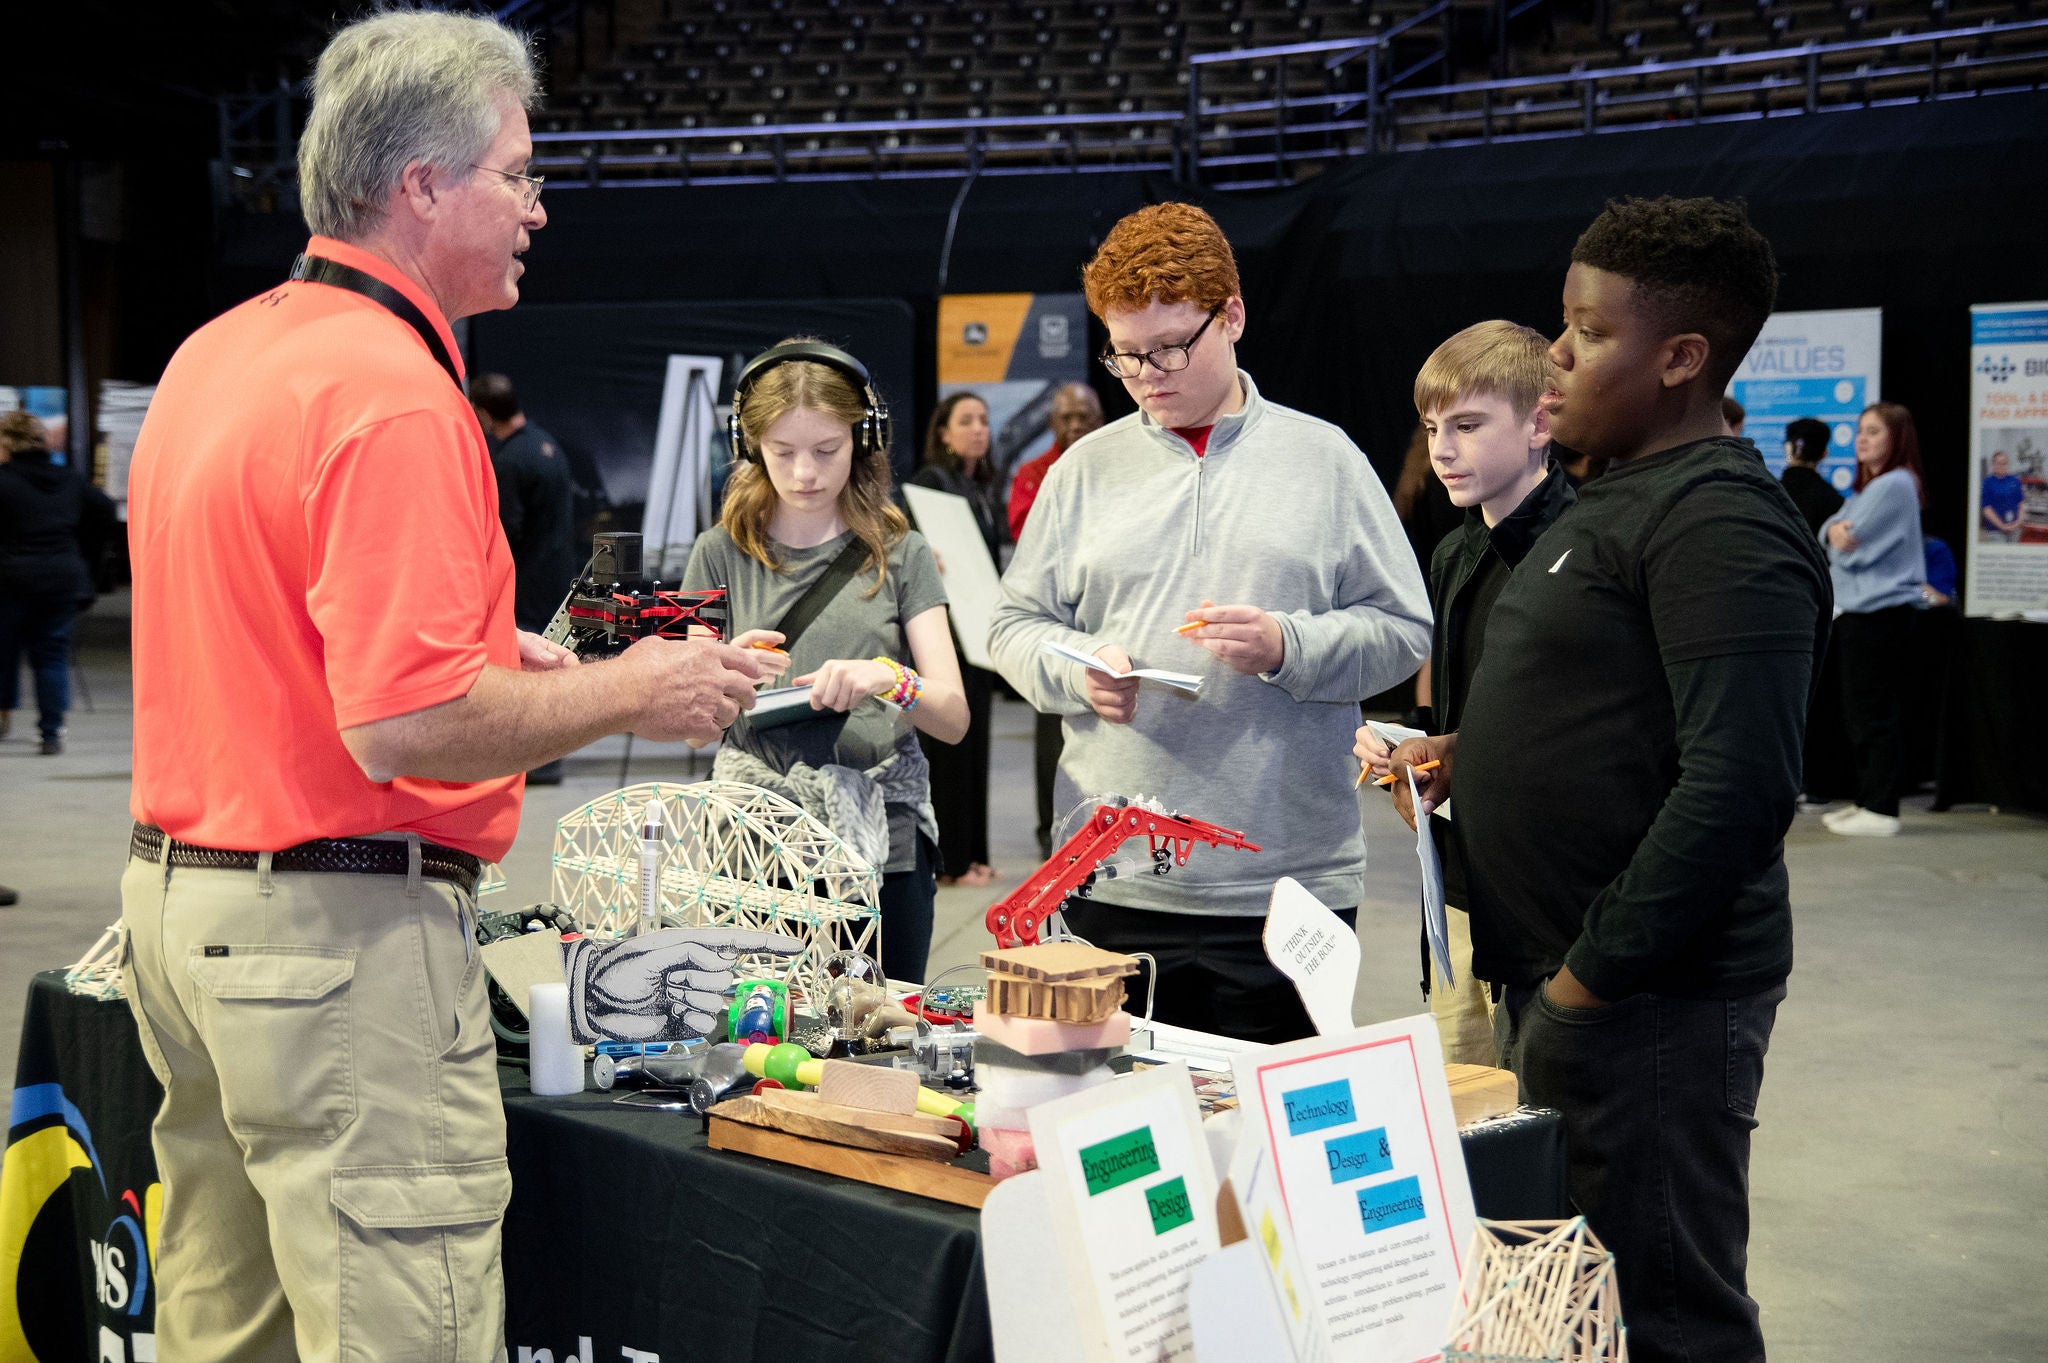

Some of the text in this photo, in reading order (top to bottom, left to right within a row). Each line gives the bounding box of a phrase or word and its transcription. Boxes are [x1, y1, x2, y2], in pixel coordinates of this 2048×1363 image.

[1747, 346, 1845, 374] VALUES
[1295, 928, 1325, 963] OUTSIDE
[1303, 956, 1320, 975] THE
[1284, 1098, 1349, 1123] Technology
[1082, 1140, 1158, 1183] Engineering
[1326, 1137, 1391, 1171] Design &
[1148, 1191, 1191, 1221] Design
[1359, 1194, 1424, 1222] Engineering
[1351, 1266, 1383, 1280] engineering
[1354, 1283, 1386, 1297] introduction
[1328, 1311, 1354, 1325] principles
[1382, 1296, 1404, 1309] problem
[1331, 1328, 1354, 1343] physical
